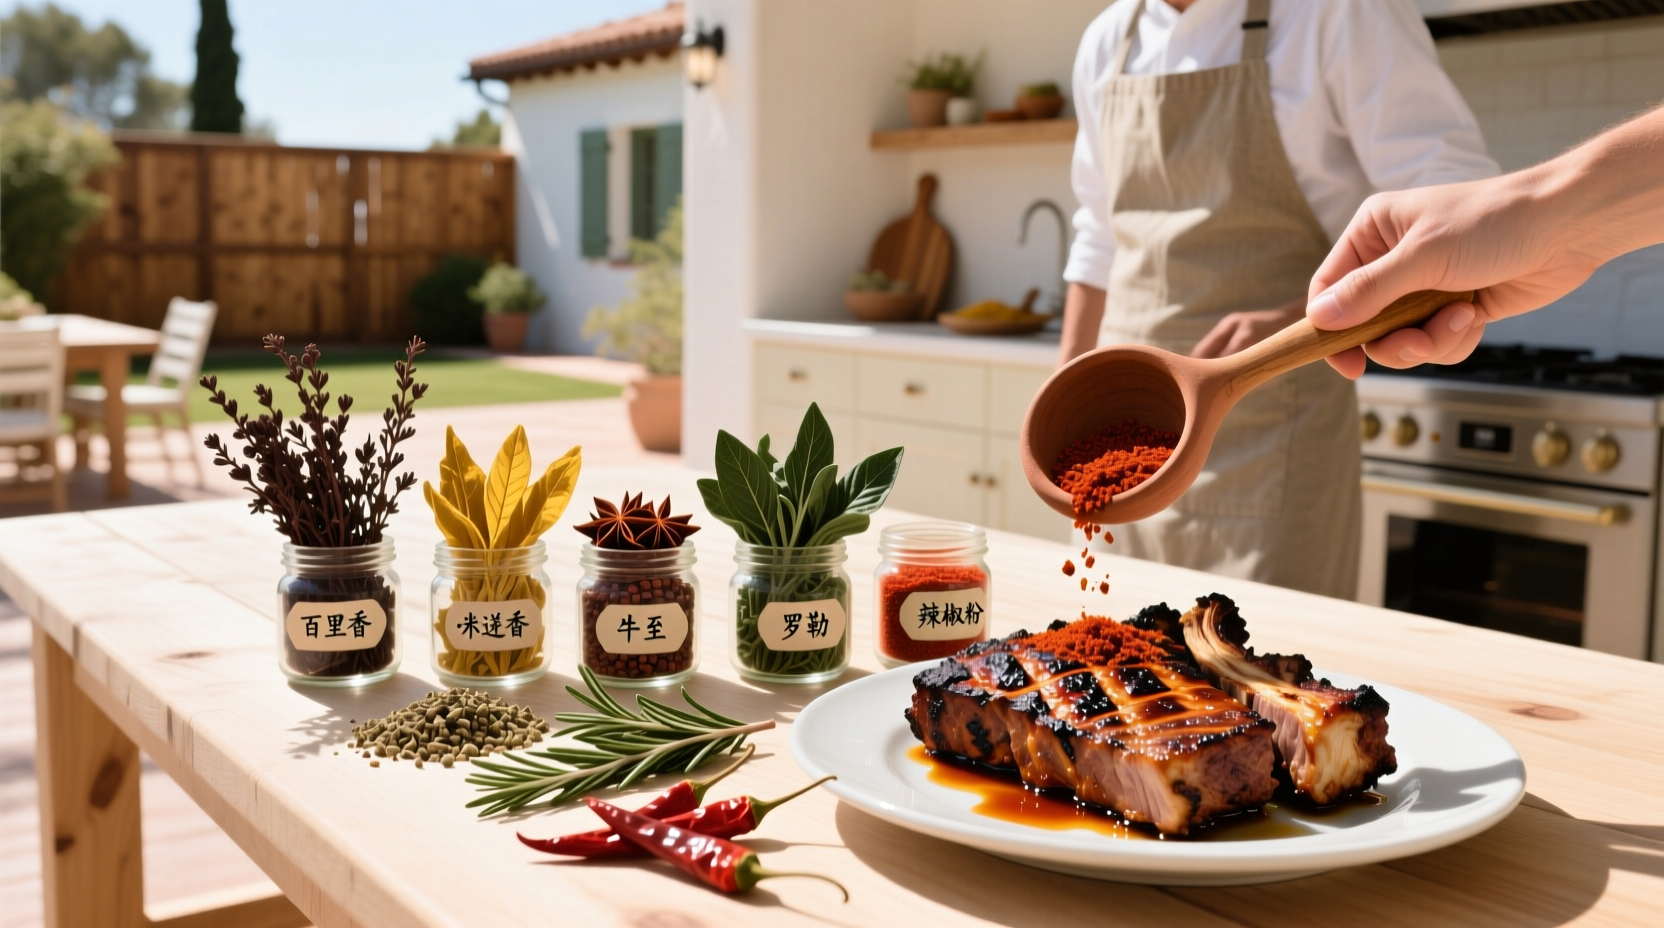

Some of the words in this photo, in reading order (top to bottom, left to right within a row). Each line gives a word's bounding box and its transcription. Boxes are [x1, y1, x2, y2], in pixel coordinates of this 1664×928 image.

[300, 609, 373, 639] 百里香
[616, 613, 667, 644] 牛至
[781, 610, 829, 641] 罗勒
[916, 600, 984, 629] 辣椒粉
